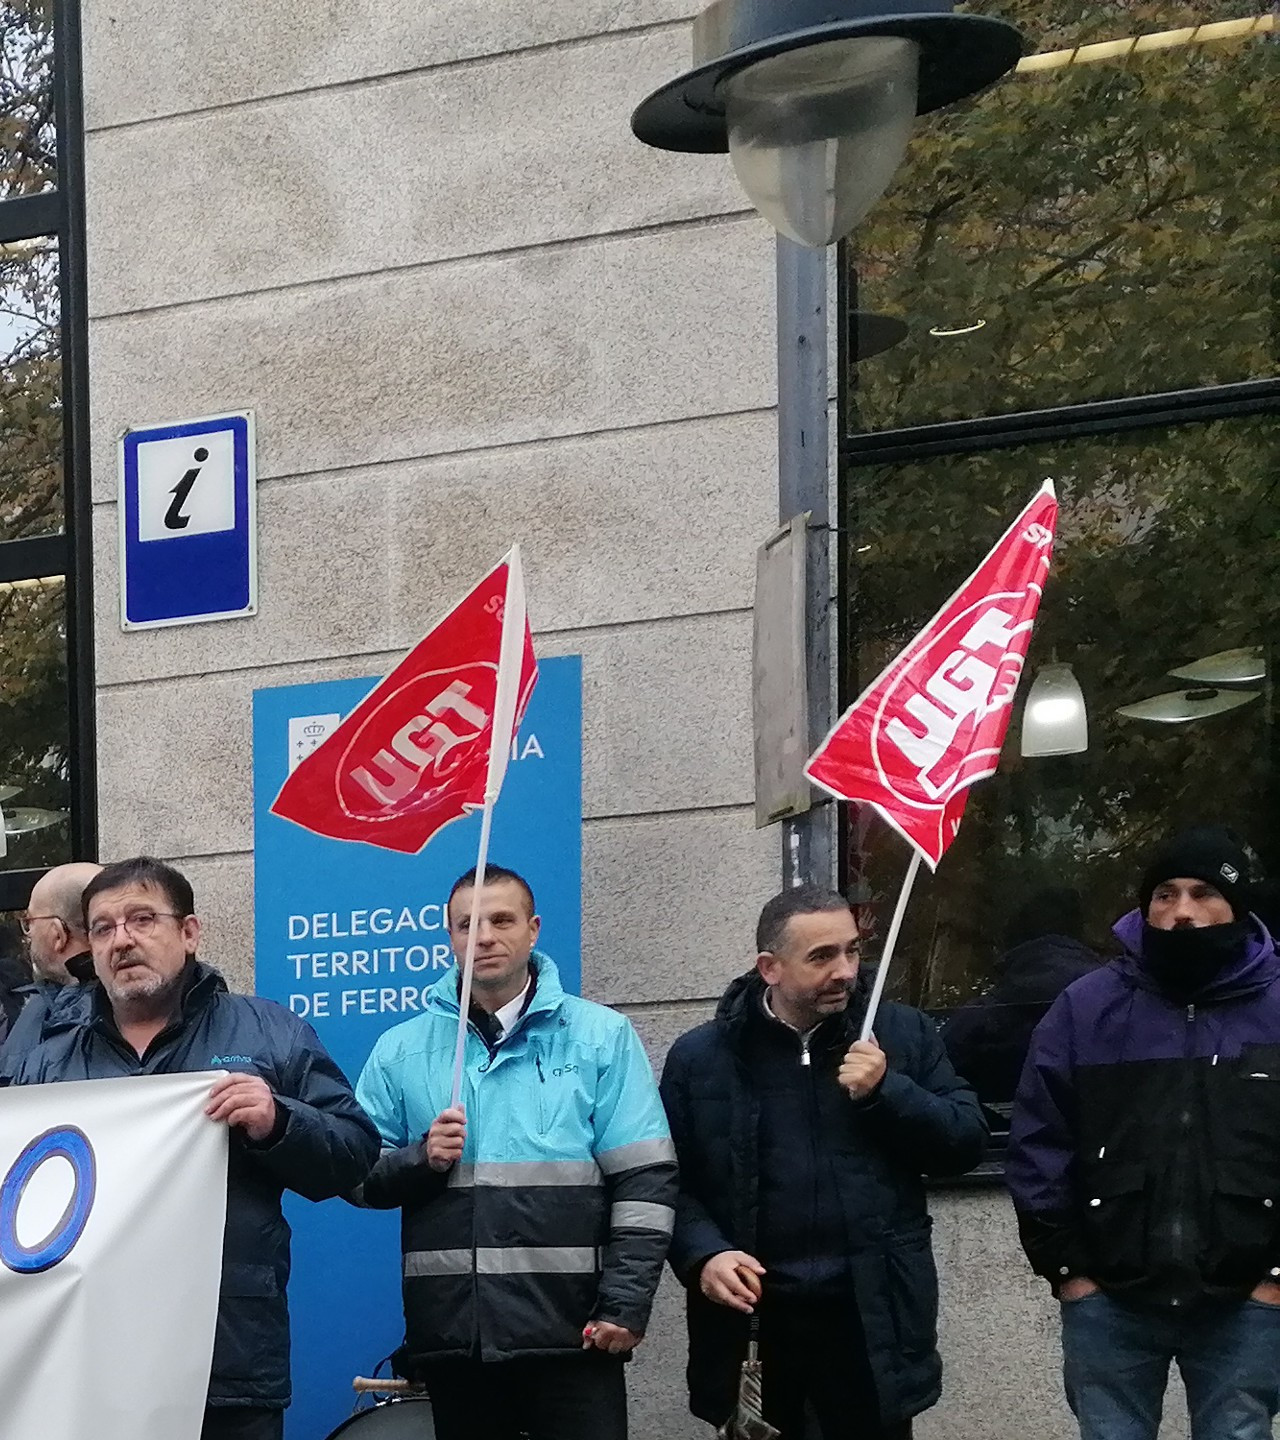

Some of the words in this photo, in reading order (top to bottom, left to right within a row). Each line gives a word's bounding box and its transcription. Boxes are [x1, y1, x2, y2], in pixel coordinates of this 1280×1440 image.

[885, 607, 1017, 768] UGT
[349, 679, 491, 805] UGT
[288, 903, 449, 940] DELEGACI
[287, 944, 458, 979] TERRITOR
[290, 992, 331, 1018] DE
